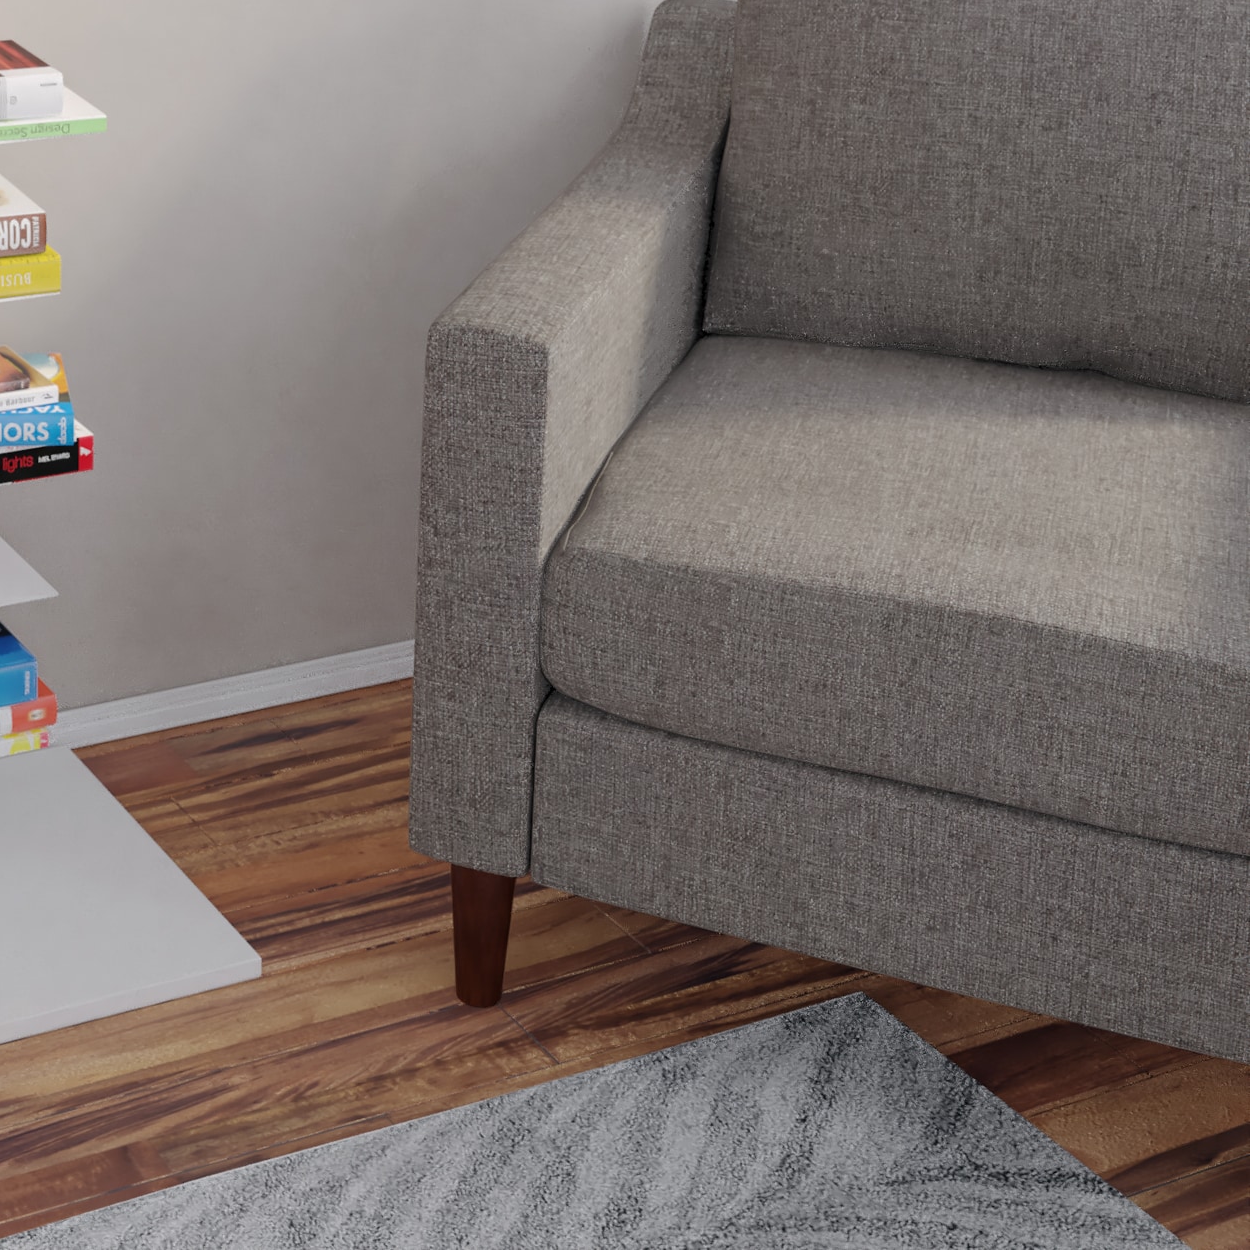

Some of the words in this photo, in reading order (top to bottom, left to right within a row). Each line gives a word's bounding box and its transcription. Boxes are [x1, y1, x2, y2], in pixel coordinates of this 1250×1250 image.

[30, 123, 70, 136] Design
[32, 216, 40, 248] PATRICIA
[2, 455, 34, 473] lights
